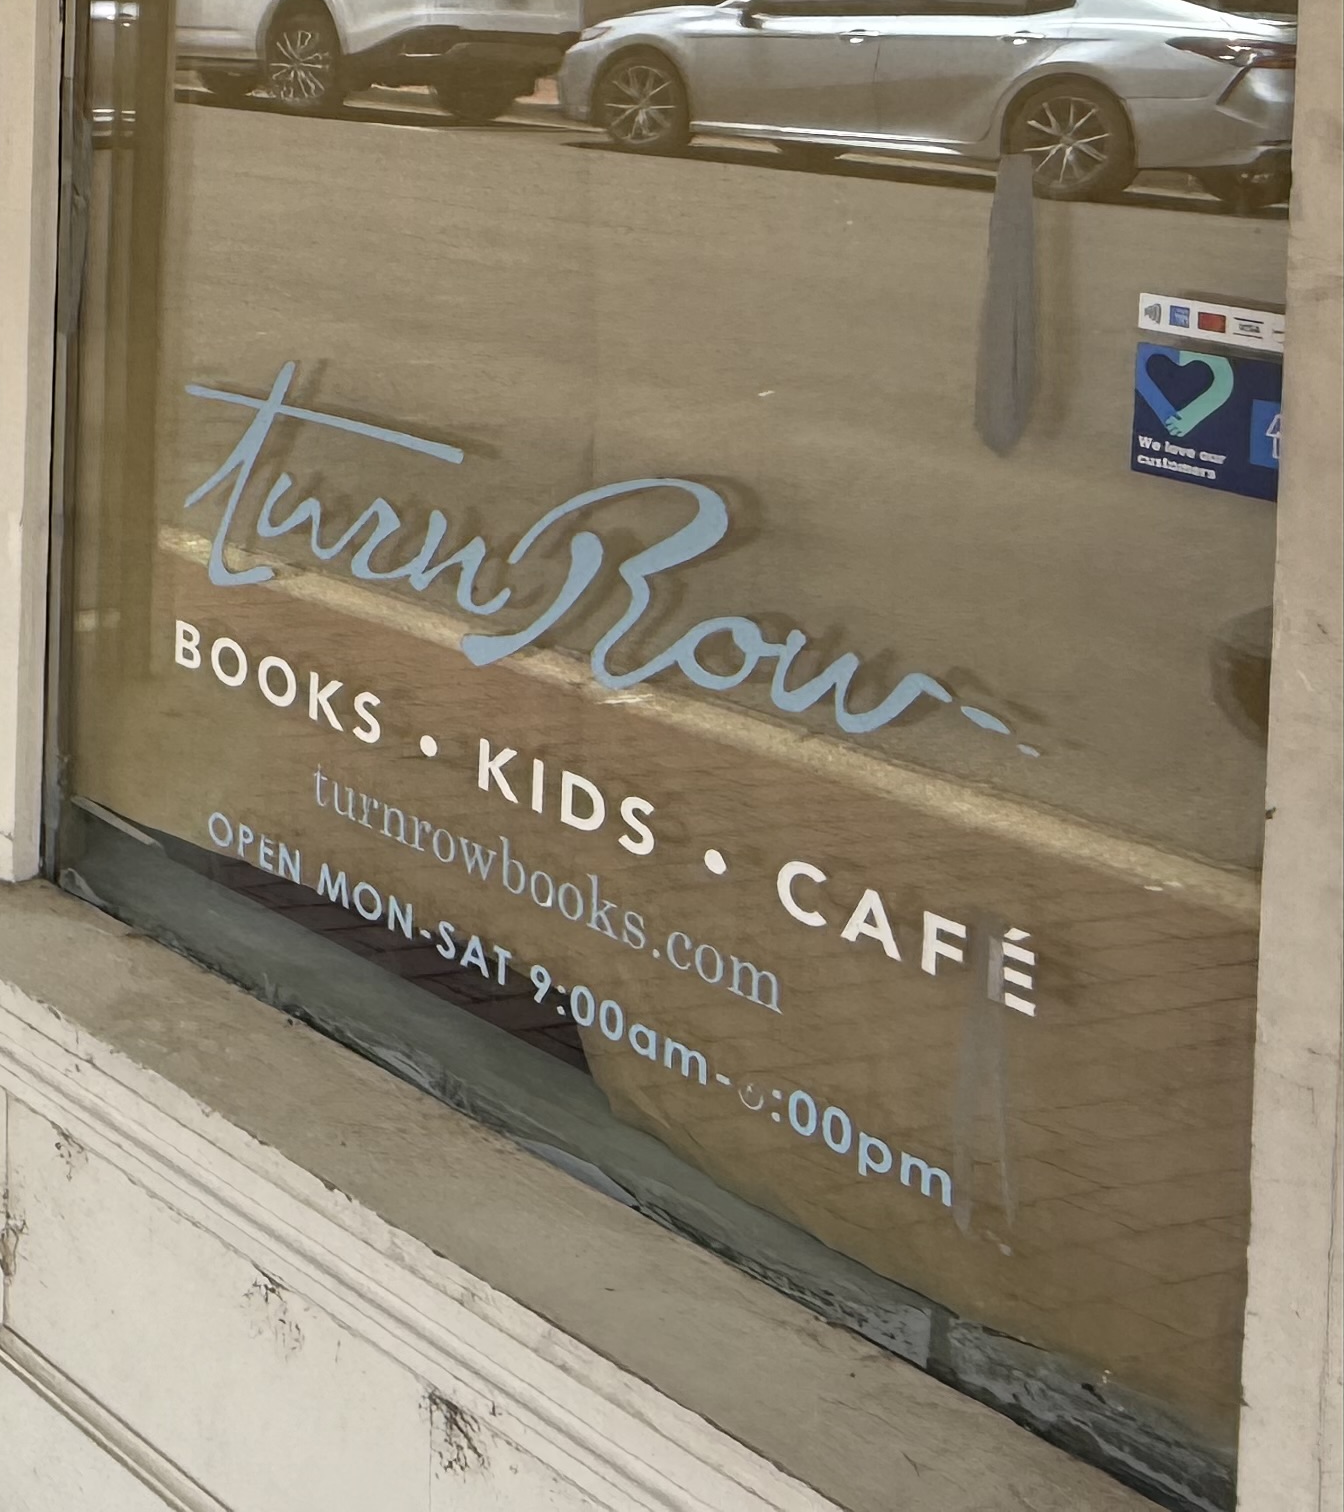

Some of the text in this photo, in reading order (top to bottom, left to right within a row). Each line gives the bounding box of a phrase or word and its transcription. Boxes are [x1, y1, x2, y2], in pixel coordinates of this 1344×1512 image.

[1138, 435, 1226, 465] We love our
[174, 619, 1036, 1017] BOOKS KIDS CAFÉ
[208, 811, 302, 885] OPEN
[317, 863, 513, 986] MON-SAT
[313, 764, 784, 1015] turnrowbooks.com
